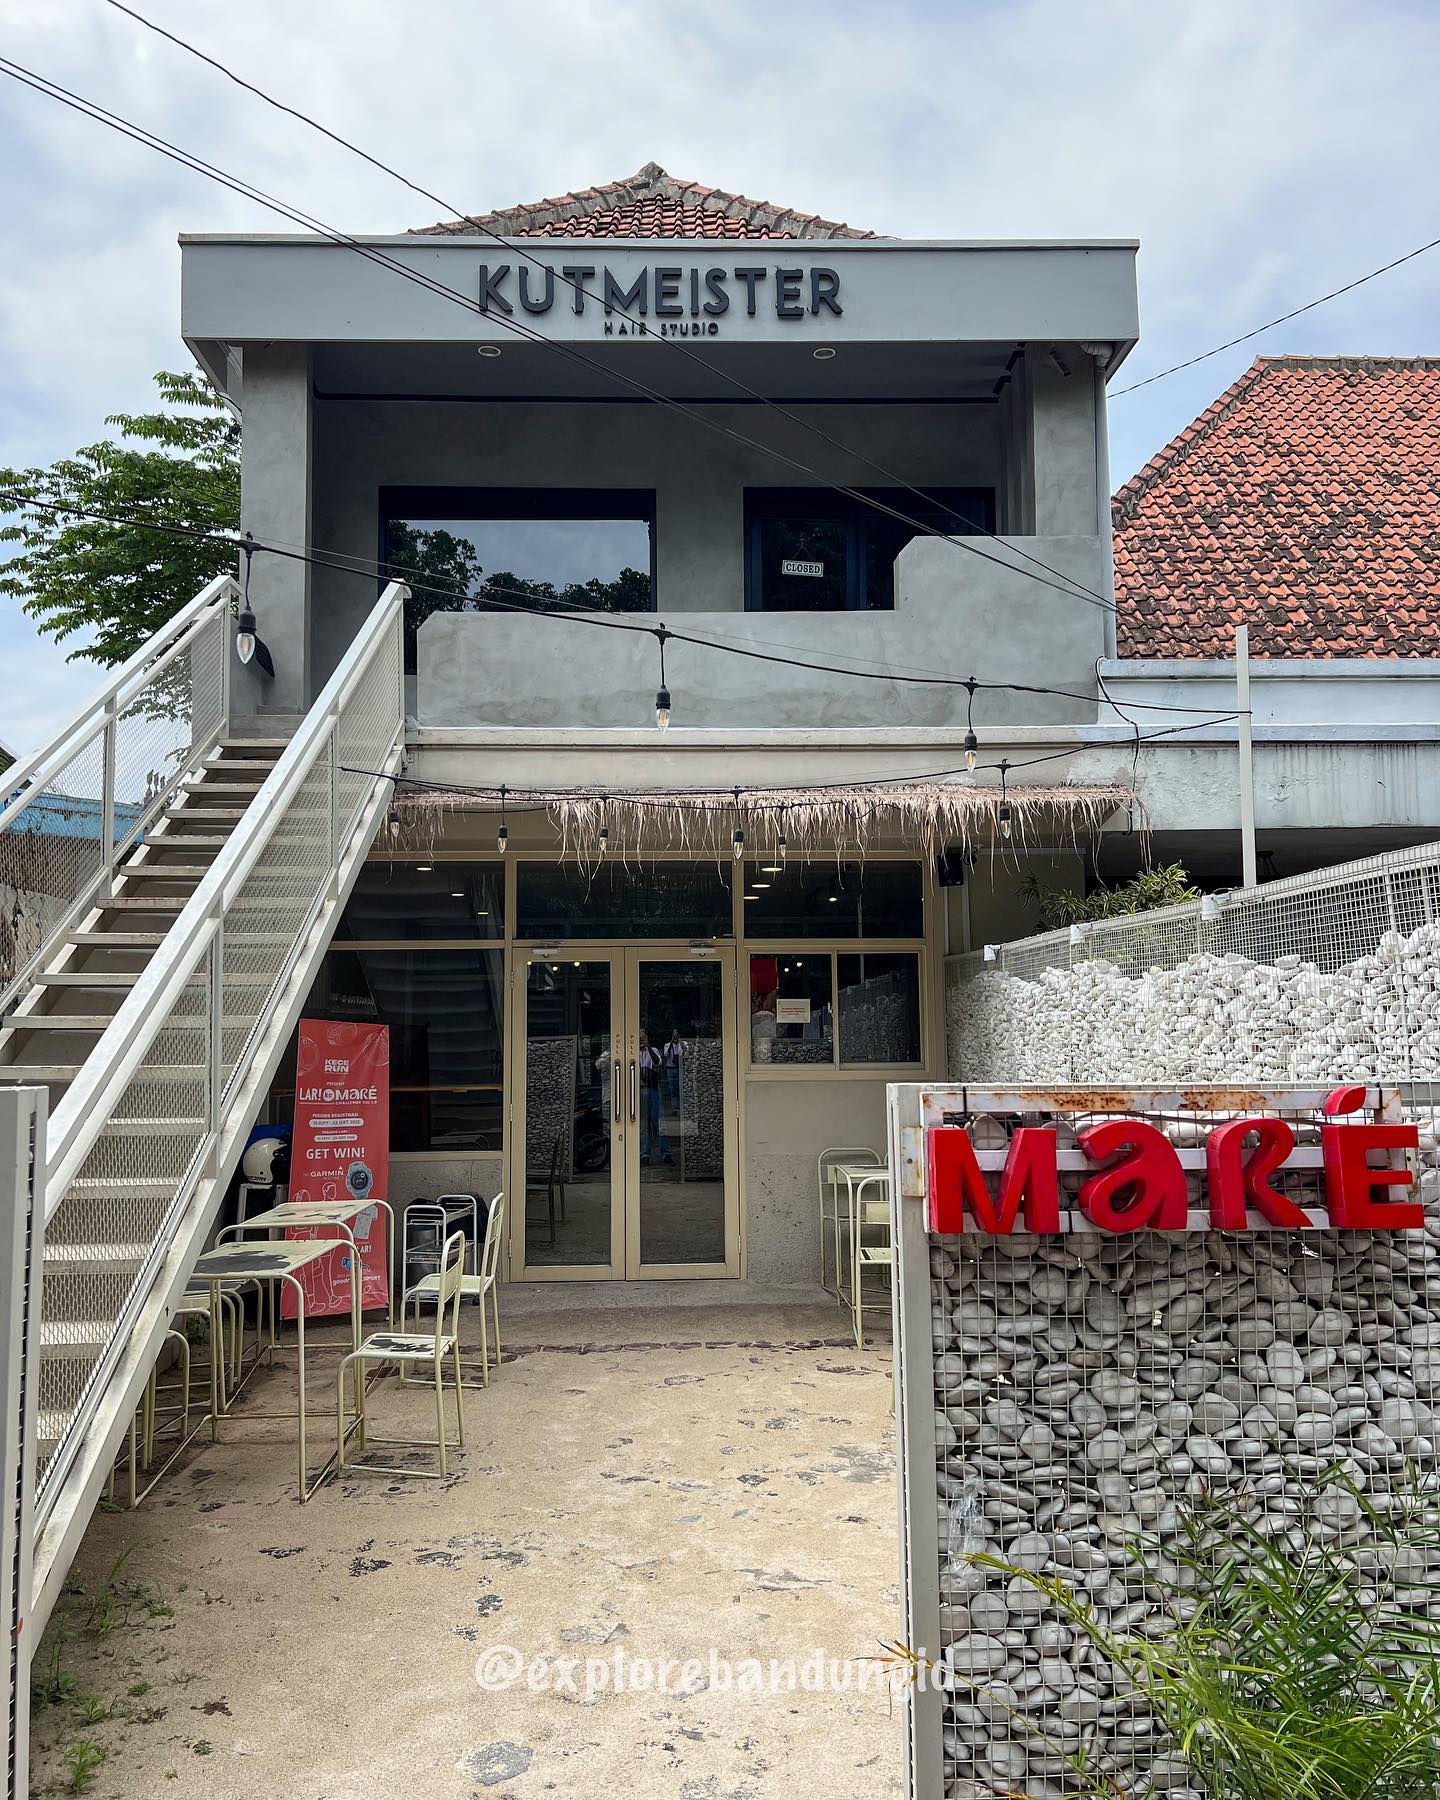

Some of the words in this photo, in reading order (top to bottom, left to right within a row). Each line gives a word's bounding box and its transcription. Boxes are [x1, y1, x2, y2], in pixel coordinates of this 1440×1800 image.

[479, 265, 843, 318] KUTMEISTER
[604, 322, 647, 336] HAIR
[660, 322, 719, 336] STUDIO
[786, 564, 820, 573] CLOSED
[324, 1065, 349, 1073] RUN
[306, 1148, 330, 1159] GET
[333, 1147, 365, 1159] WIN!
[310, 1169, 344, 1177] GARMIN
